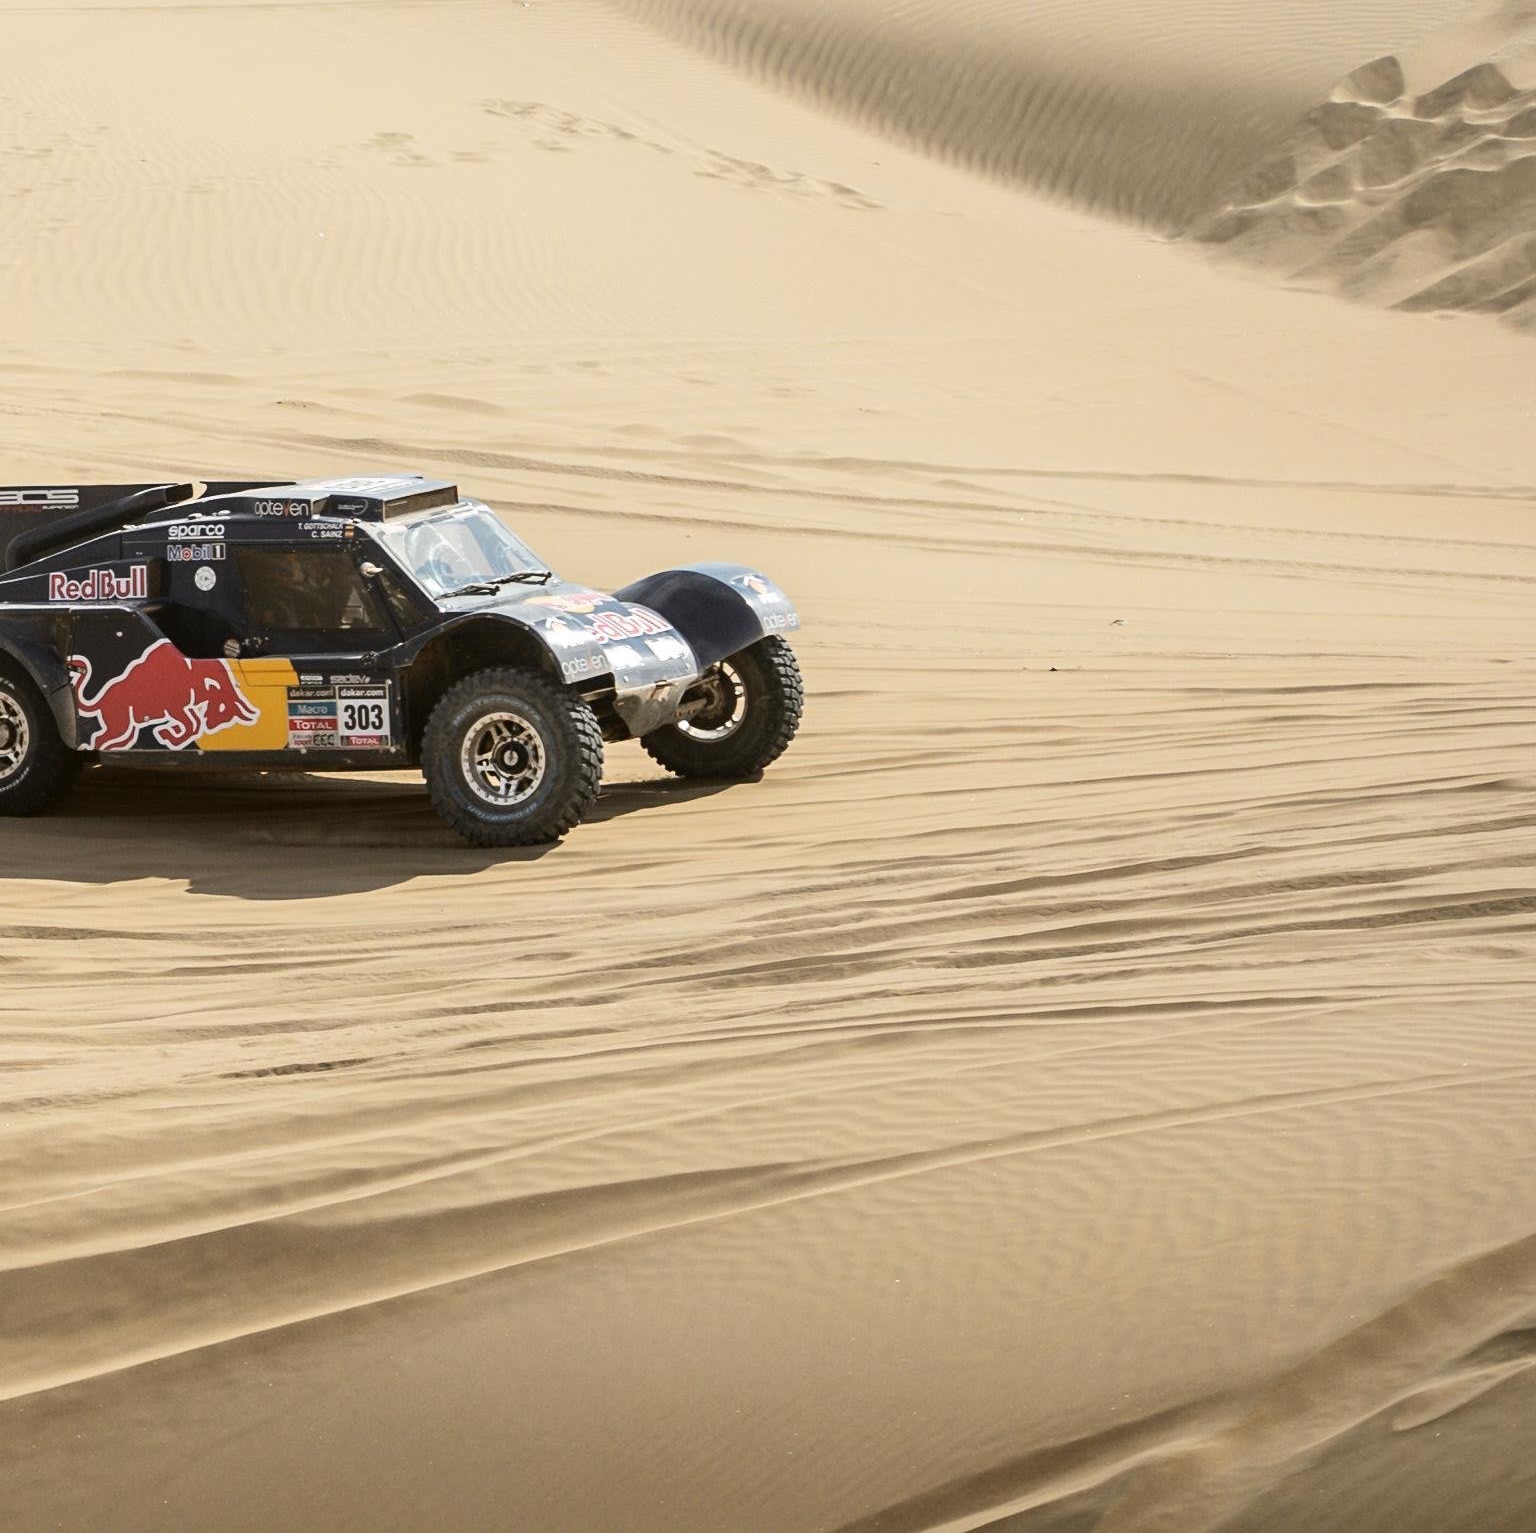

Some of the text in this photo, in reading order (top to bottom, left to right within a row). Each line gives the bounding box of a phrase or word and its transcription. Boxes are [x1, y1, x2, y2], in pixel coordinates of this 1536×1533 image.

[168, 524, 225, 539] sparco
[167, 544, 212, 561] Mobil
[340, 688, 384, 697] dakar.com
[297, 705, 328, 715] Macro
[343, 704, 384, 731] 303
[294, 720, 333, 729] TOTAL
